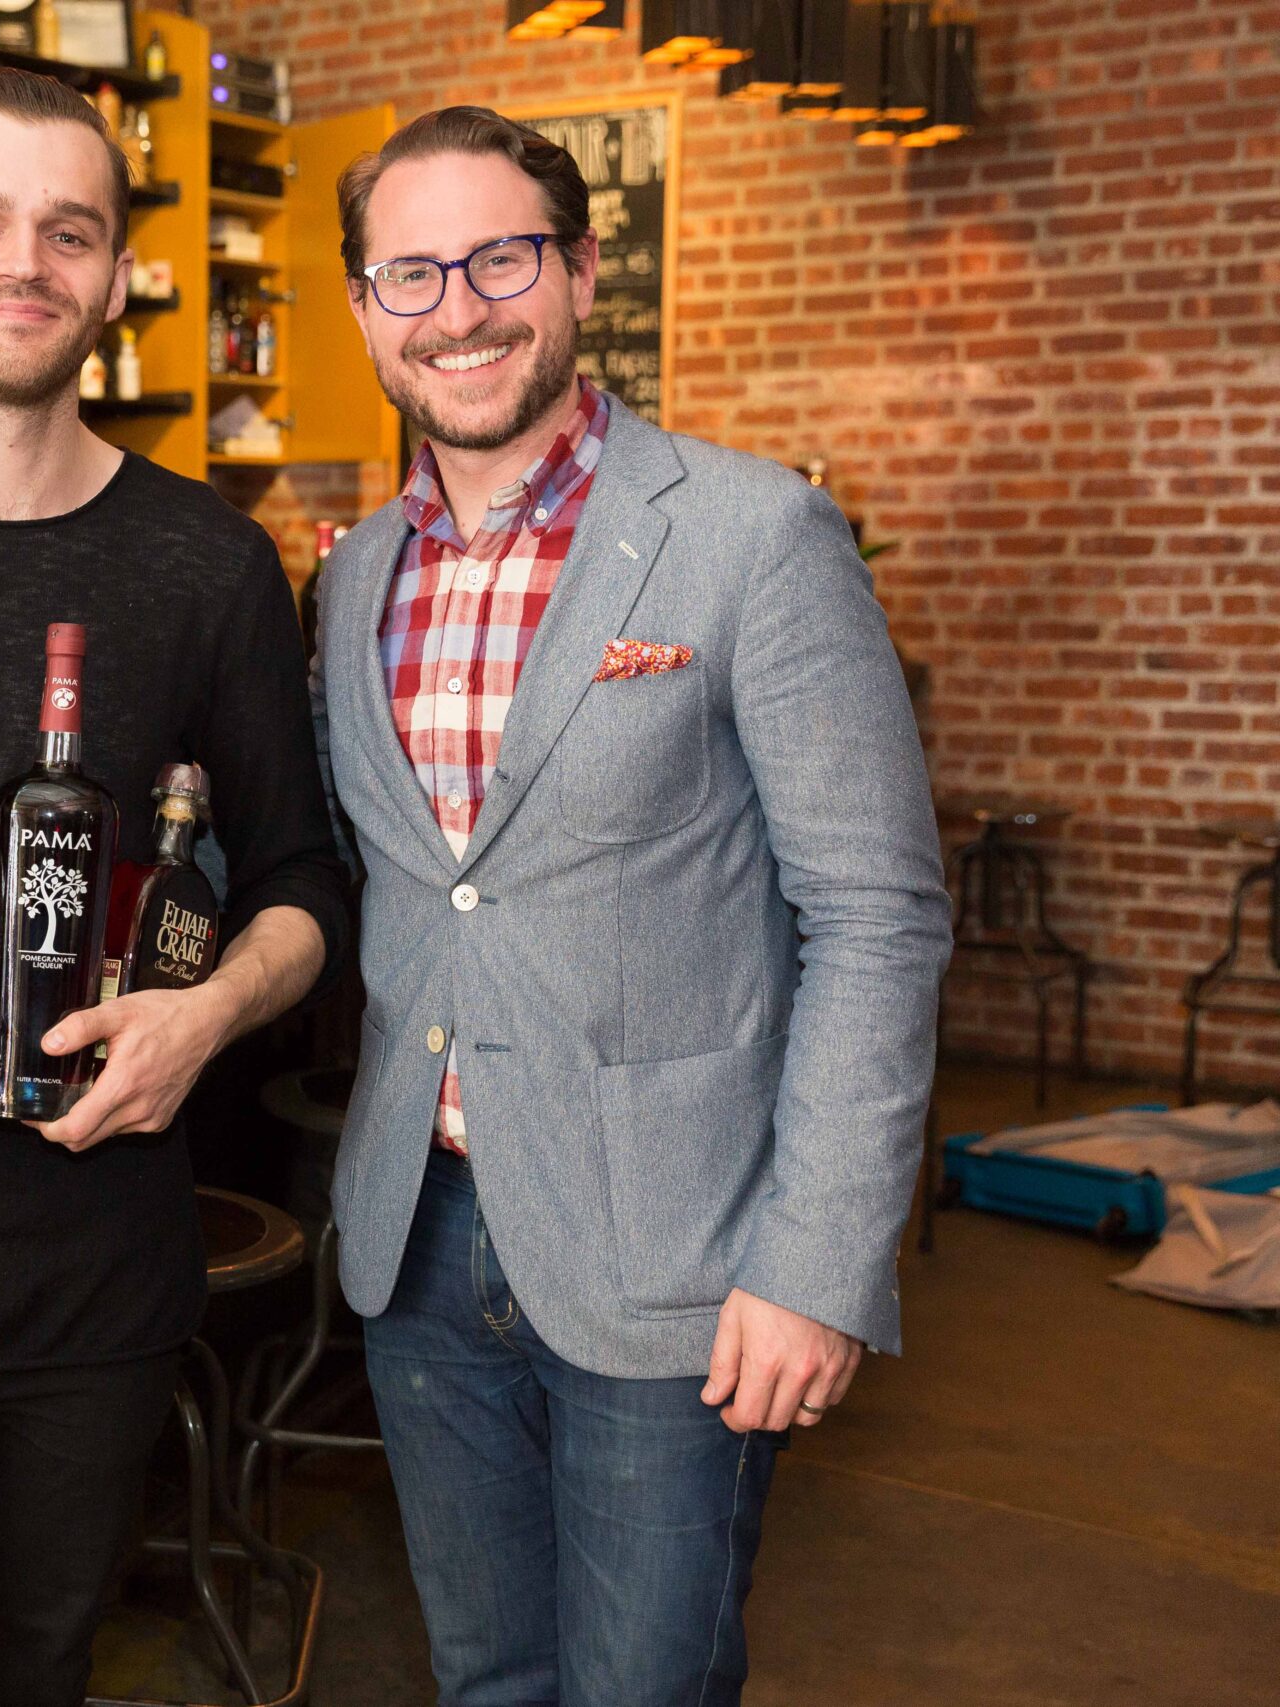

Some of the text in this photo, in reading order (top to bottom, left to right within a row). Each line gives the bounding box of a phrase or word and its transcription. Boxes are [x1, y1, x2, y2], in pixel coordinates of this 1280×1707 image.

[52, 677, 78, 686] PAMA
[20, 828, 92, 851] PAMA
[160, 898, 210, 941] ELIJAH
[156, 925, 204, 966] CRAIG
[20, 954, 76, 964] POMEGRANATE
[32, 961, 63, 970] LIQUEUR
[154, 956, 198, 982] Small Batch
